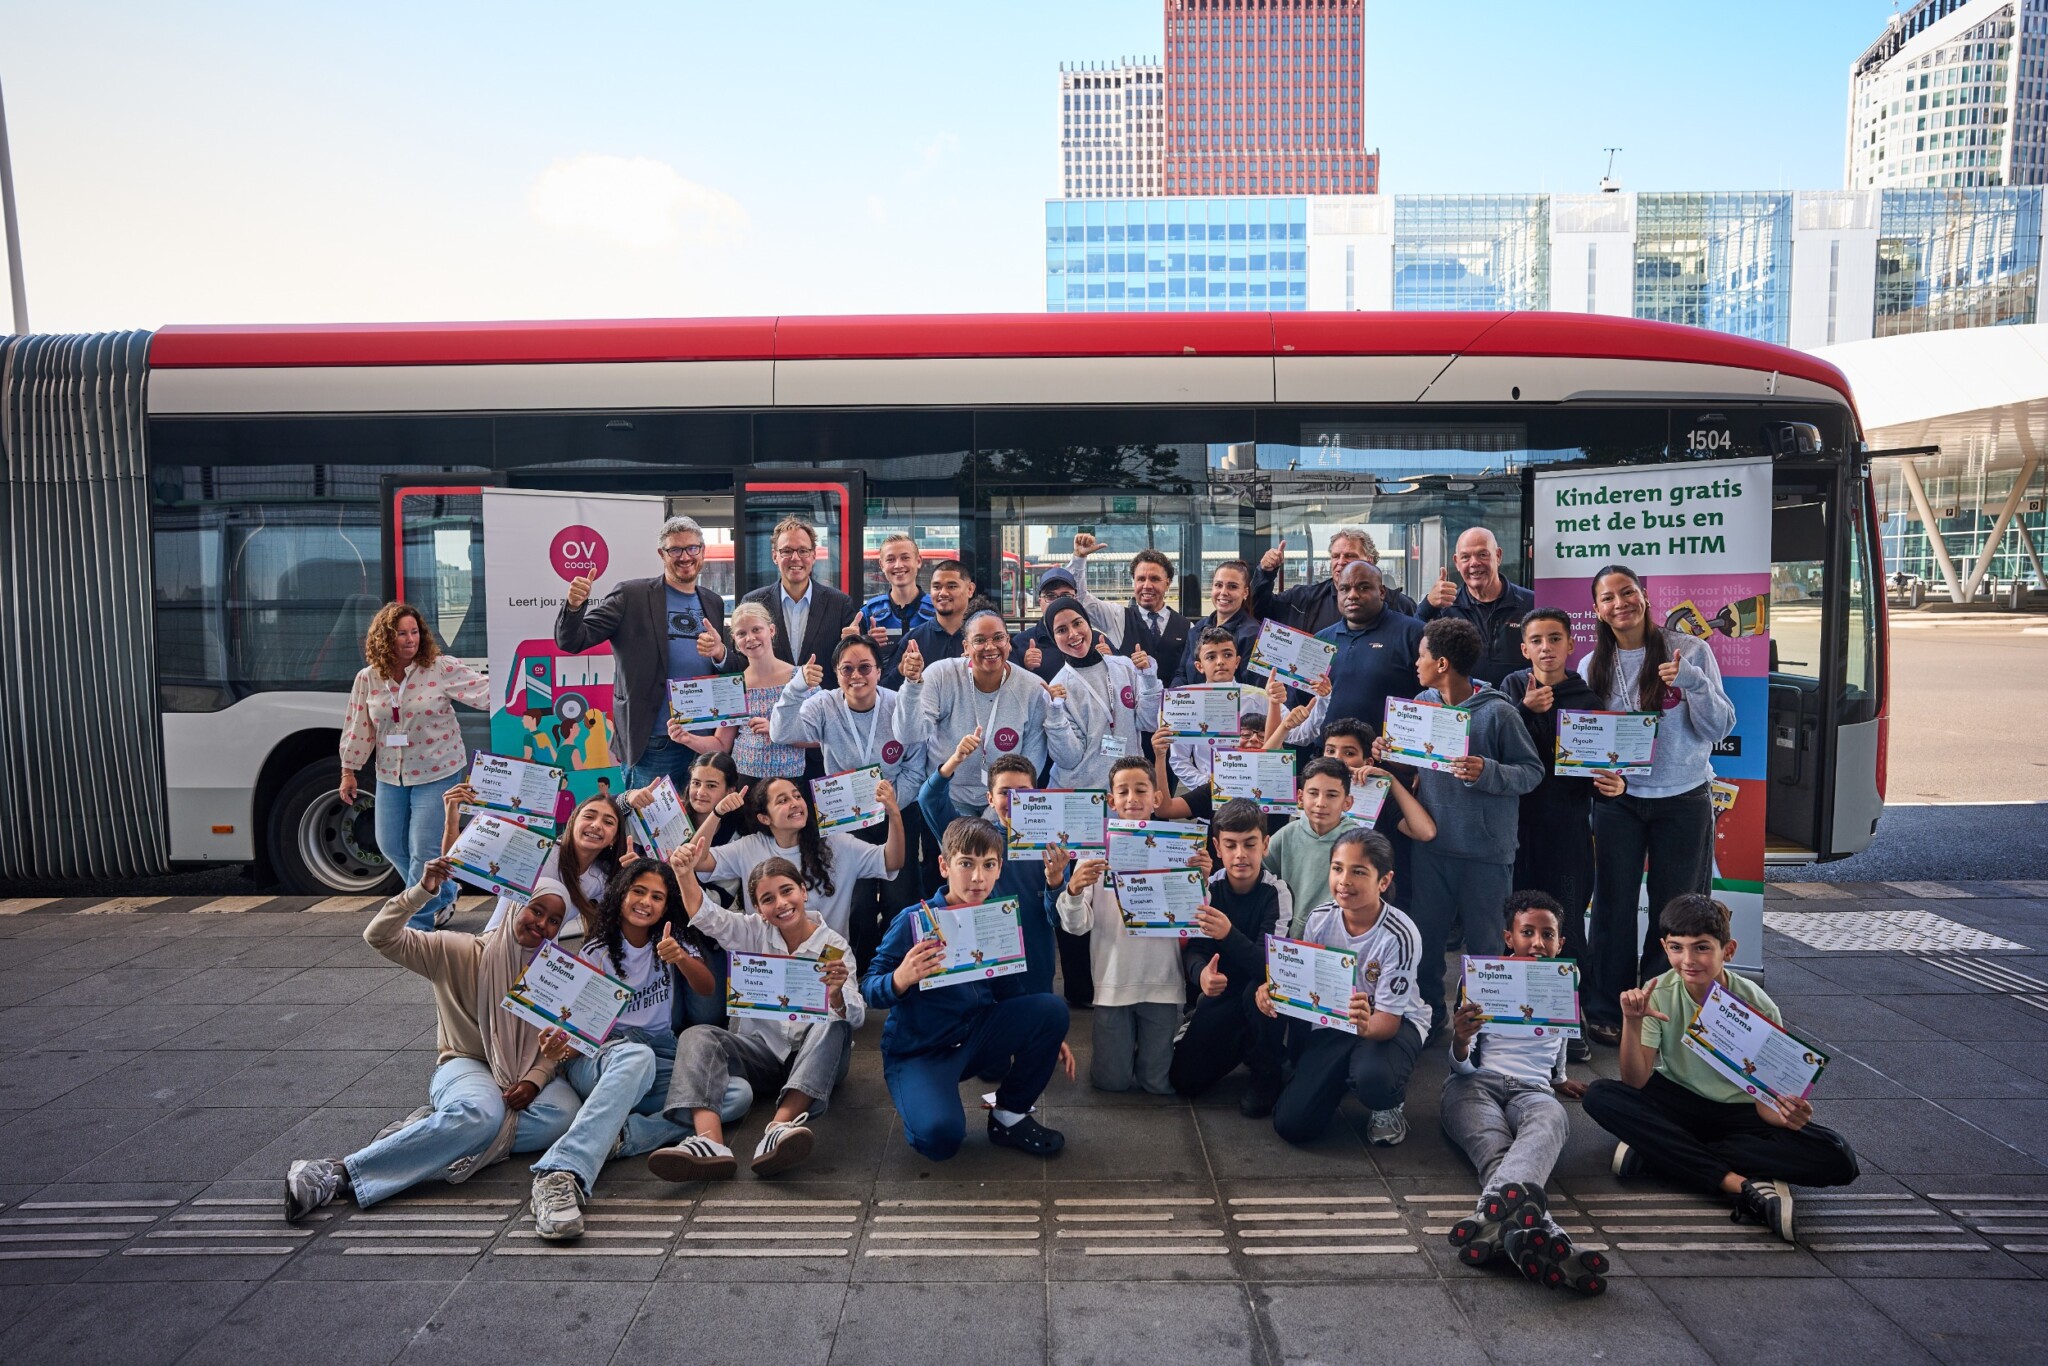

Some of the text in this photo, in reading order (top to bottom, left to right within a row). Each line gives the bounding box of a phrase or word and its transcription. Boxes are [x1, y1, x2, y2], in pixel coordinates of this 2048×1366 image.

[1687, 430, 1732, 450] 1504
[1318, 433, 1341, 466] 24
[1556, 478, 1743, 507] Kinderen gratis
[1555, 510, 1724, 533] met de bus en
[562, 541, 596, 559] OV
[1555, 535, 1726, 559] tram van HTM
[564, 560, 597, 569] coach
[1659, 584, 1753, 597] Kids voor Niks
[509, 597, 537, 607] Leert
[540, 597, 557, 609] jou
[1659, 598, 1680, 608] Kid
[1270, 633, 1293, 645] Diploma
[1722, 644, 1751, 655] Niks
[1722, 655, 1751, 667] Niks
[1396, 711, 1422, 721] Diploma
[1572, 724, 1604, 732] Diploma
[999, 733, 1015, 743] OV
[886, 745, 900, 756] OV
[483, 765, 512, 776] Diploma
[1222, 761, 1248, 769] Diploma
[822, 786, 844, 795] Diploma
[1022, 803, 1053, 812] Diploma
[475, 825, 500, 839] Diploma
[1126, 885, 1154, 893] Diploma
[1278, 952, 1305, 966] Diploma
[546, 960, 575, 981] Diploma
[742, 966, 774, 975] Diploma
[1478, 972, 1513, 981] Diploma
[643, 989, 669, 1009] BETTER
[1718, 1004, 1752, 1033] Diploma
